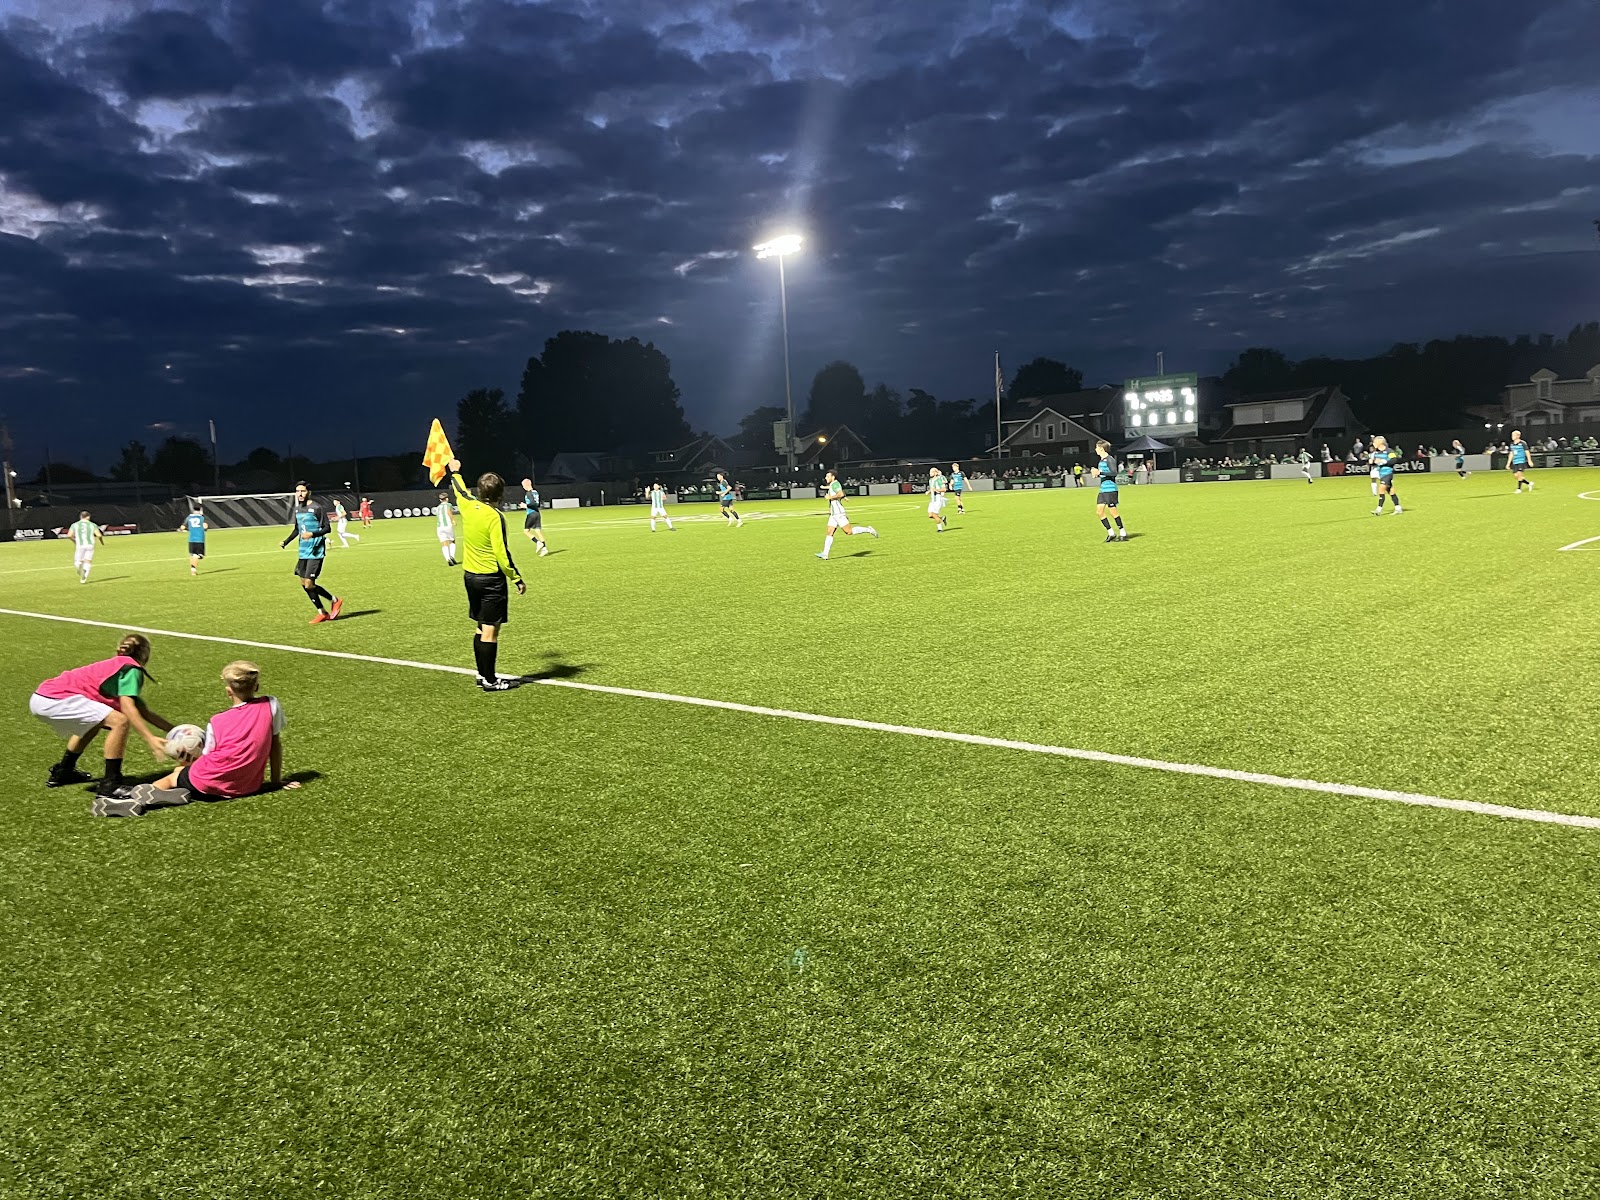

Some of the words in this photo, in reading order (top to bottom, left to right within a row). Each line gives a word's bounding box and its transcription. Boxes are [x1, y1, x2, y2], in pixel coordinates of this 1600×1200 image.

[1345, 463, 1369, 474] Steel
[1410, 460, 1425, 471] Va
[912, 484, 927, 493] Steel
[188, 517, 201, 528] 12
